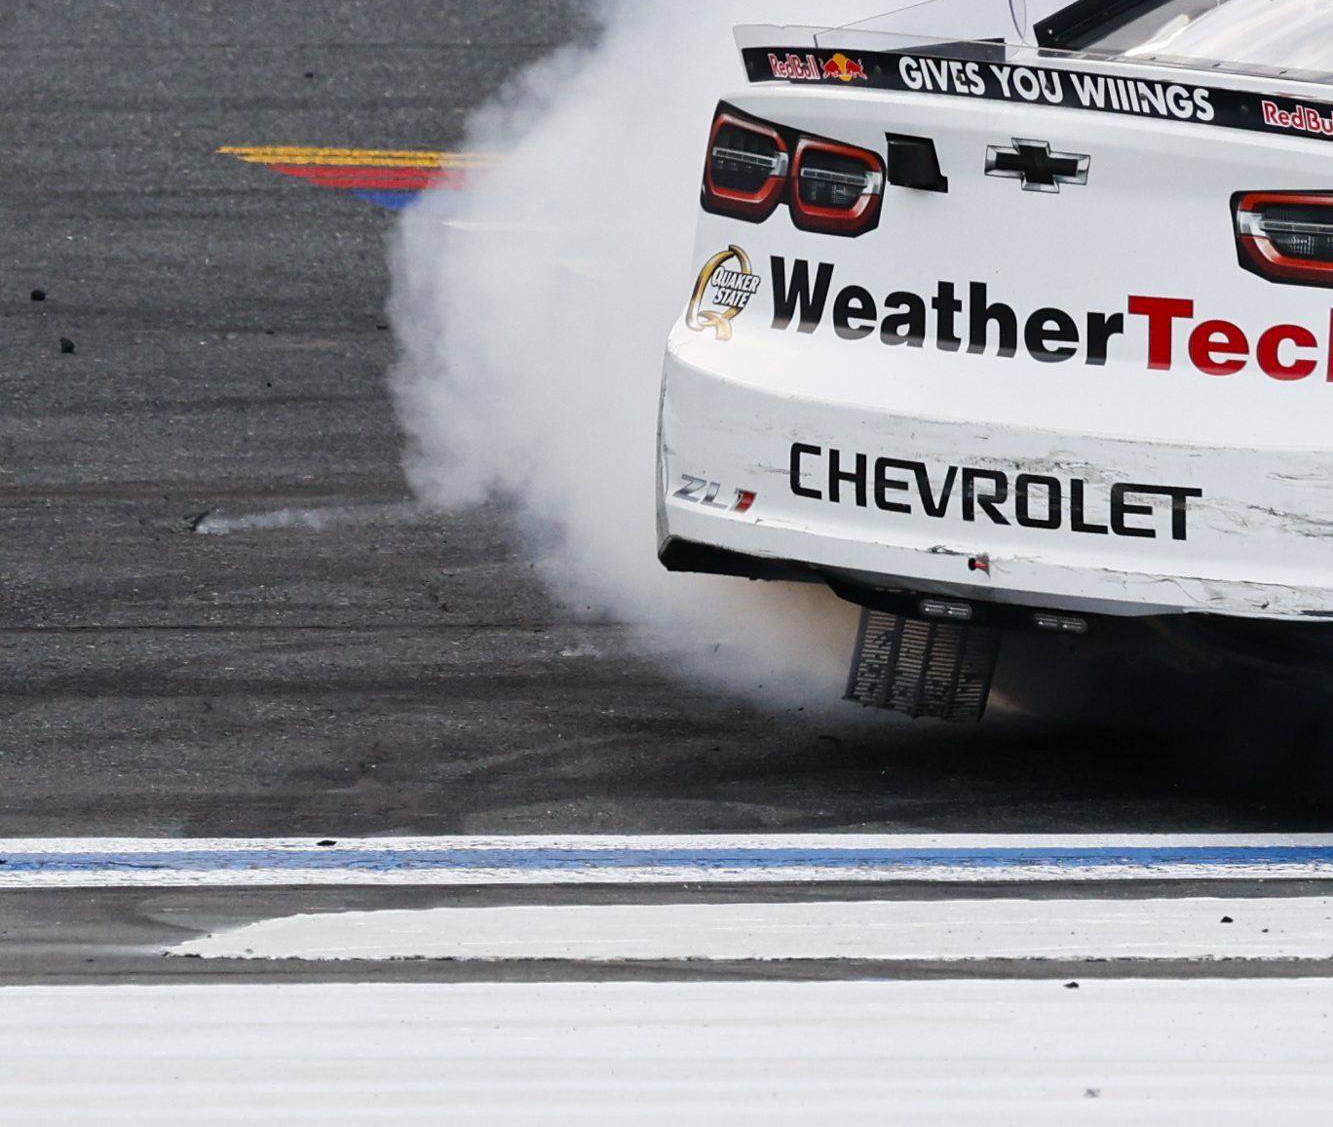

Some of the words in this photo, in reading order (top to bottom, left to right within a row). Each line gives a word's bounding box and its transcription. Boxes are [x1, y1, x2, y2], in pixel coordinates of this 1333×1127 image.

[898, 56, 985, 97] GIVES
[989, 66, 1064, 105] YOU
[1069, 73, 1215, 122] WIIINGS
[711, 265, 761, 294] QUAKER
[712, 286, 750, 309] STATE
[789, 442, 1203, 541] CHEVROLET
